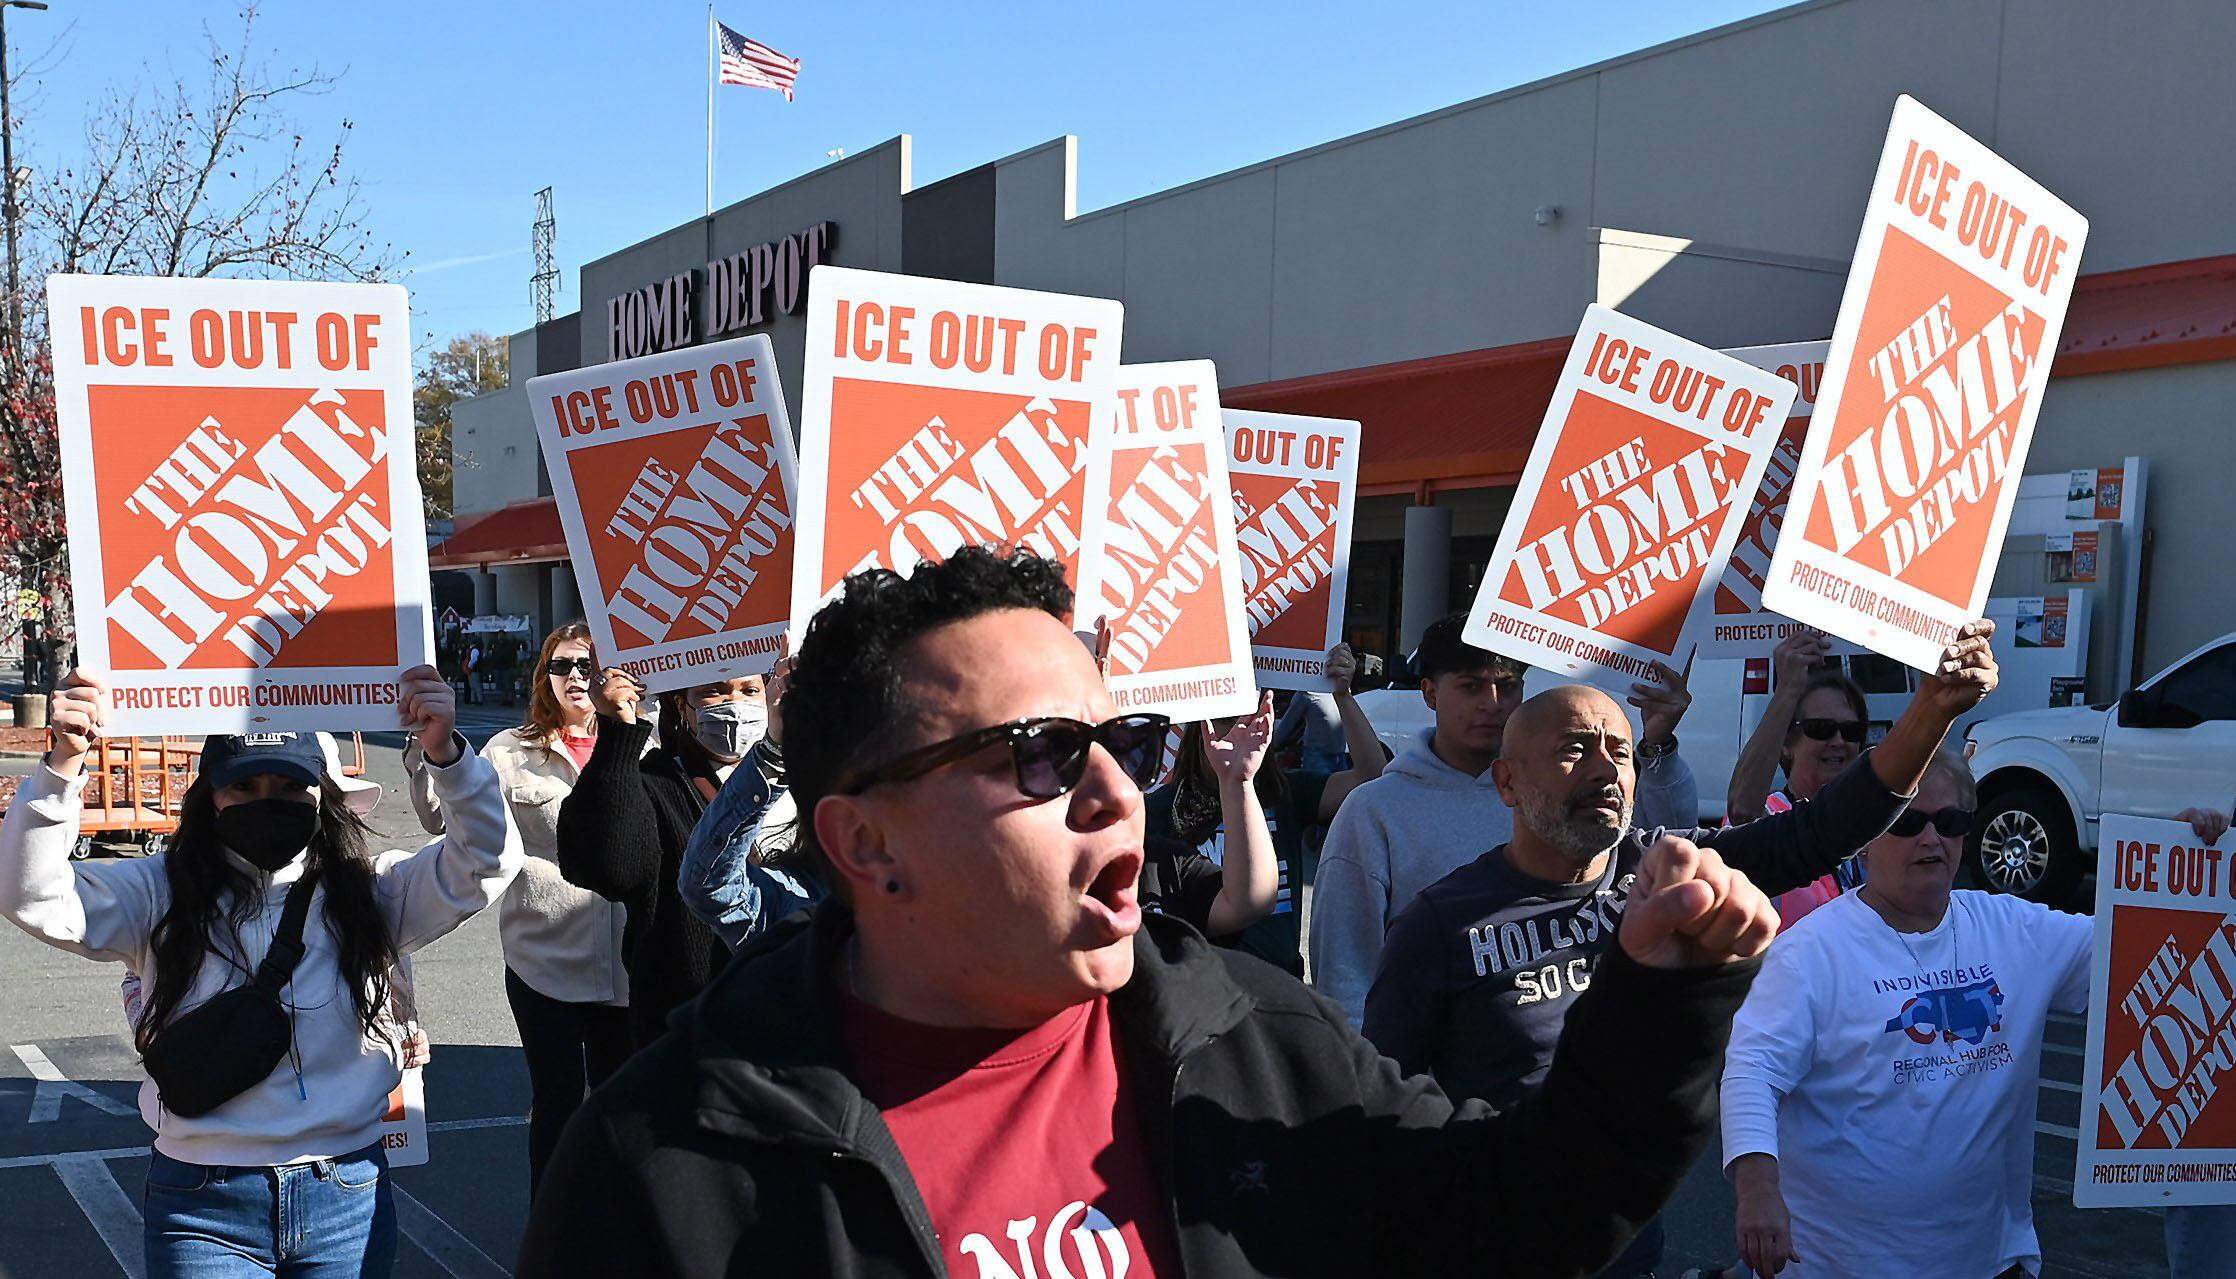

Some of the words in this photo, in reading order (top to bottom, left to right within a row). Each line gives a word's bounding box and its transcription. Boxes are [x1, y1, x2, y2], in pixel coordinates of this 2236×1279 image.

[1894, 139, 1960, 231] ICE
[1957, 181, 2026, 270] OUT
[2023, 225, 2067, 296] OF
[607, 269, 694, 362] HOME
[707, 222, 830, 336] DEPOT
[80, 306, 174, 366] ICE
[190, 308, 298, 370] OUT
[315, 312, 381, 371] OF
[834, 300, 915, 365] ICE
[929, 310, 1026, 375] OUT
[1038, 323, 1097, 382] OF
[1869, 294, 1958, 404] THE
[551, 386, 619, 438] ICE
[625, 370, 699, 424] OUT
[710, 359, 757, 408] OF
[1153, 384, 1197, 432] OF
[1584, 332, 1651, 394] ICE
[1649, 359, 1725, 421] OUT
[1722, 388, 1773, 438] OF
[1819, 300, 2034, 554] HOME
[124, 415, 248, 532] THE
[850, 415, 966, 526] THE
[1233, 427, 1297, 466] OUT
[1304, 434, 1344, 470] OF
[1561, 436, 1653, 510] THE
[107, 386, 390, 669] HOME
[605, 457, 680, 544] THE
[605, 420, 778, 645] HOME
[1514, 440, 1740, 611] HOME
[1880, 420, 2009, 578] DEPOT
[222, 492, 392, 668] DEPOT
[688, 492, 792, 633] DEPOT
[1110, 525, 1219, 674] DEPOT
[1575, 523, 1711, 630] DEPOT
[1791, 560, 1851, 609] PROTECT
[1850, 585, 1876, 617] OUR
[1877, 596, 1959, 647] COMMUNITIES
[621, 652, 682, 677] PROTECT
[686, 647, 714, 666] OUR
[717, 634, 783, 660] COMMUN
[1487, 612, 1547, 644] PROTECT
[1547, 631, 1574, 654] OUR
[1715, 625, 1774, 641] PROTECT
[112, 686, 203, 709] PROTECT
[209, 684, 250, 707] OUR
[255, 682, 400, 706] COMMUNITIES!
[1133, 677, 1236, 705] COMMUNITIES!
[2114, 840, 2160, 892] ICE
[2168, 845, 2222, 898] OUT
[1874, 964, 1993, 994] INDIVISIBLE
[2120, 934, 2187, 1029] THE
[1944, 1053, 2014, 1080] ACTIVISM
[1959, 1047, 1986, 1062] HUB
[1985, 1043, 2009, 1058] FOR
[2157, 1009, 2236, 1150] DEPO
[2093, 1164, 2141, 1183] PROTECT
[2143, 1164, 2165, 1183] OUR
[2167, 1163, 2236, 1183] COMMUNITIES
